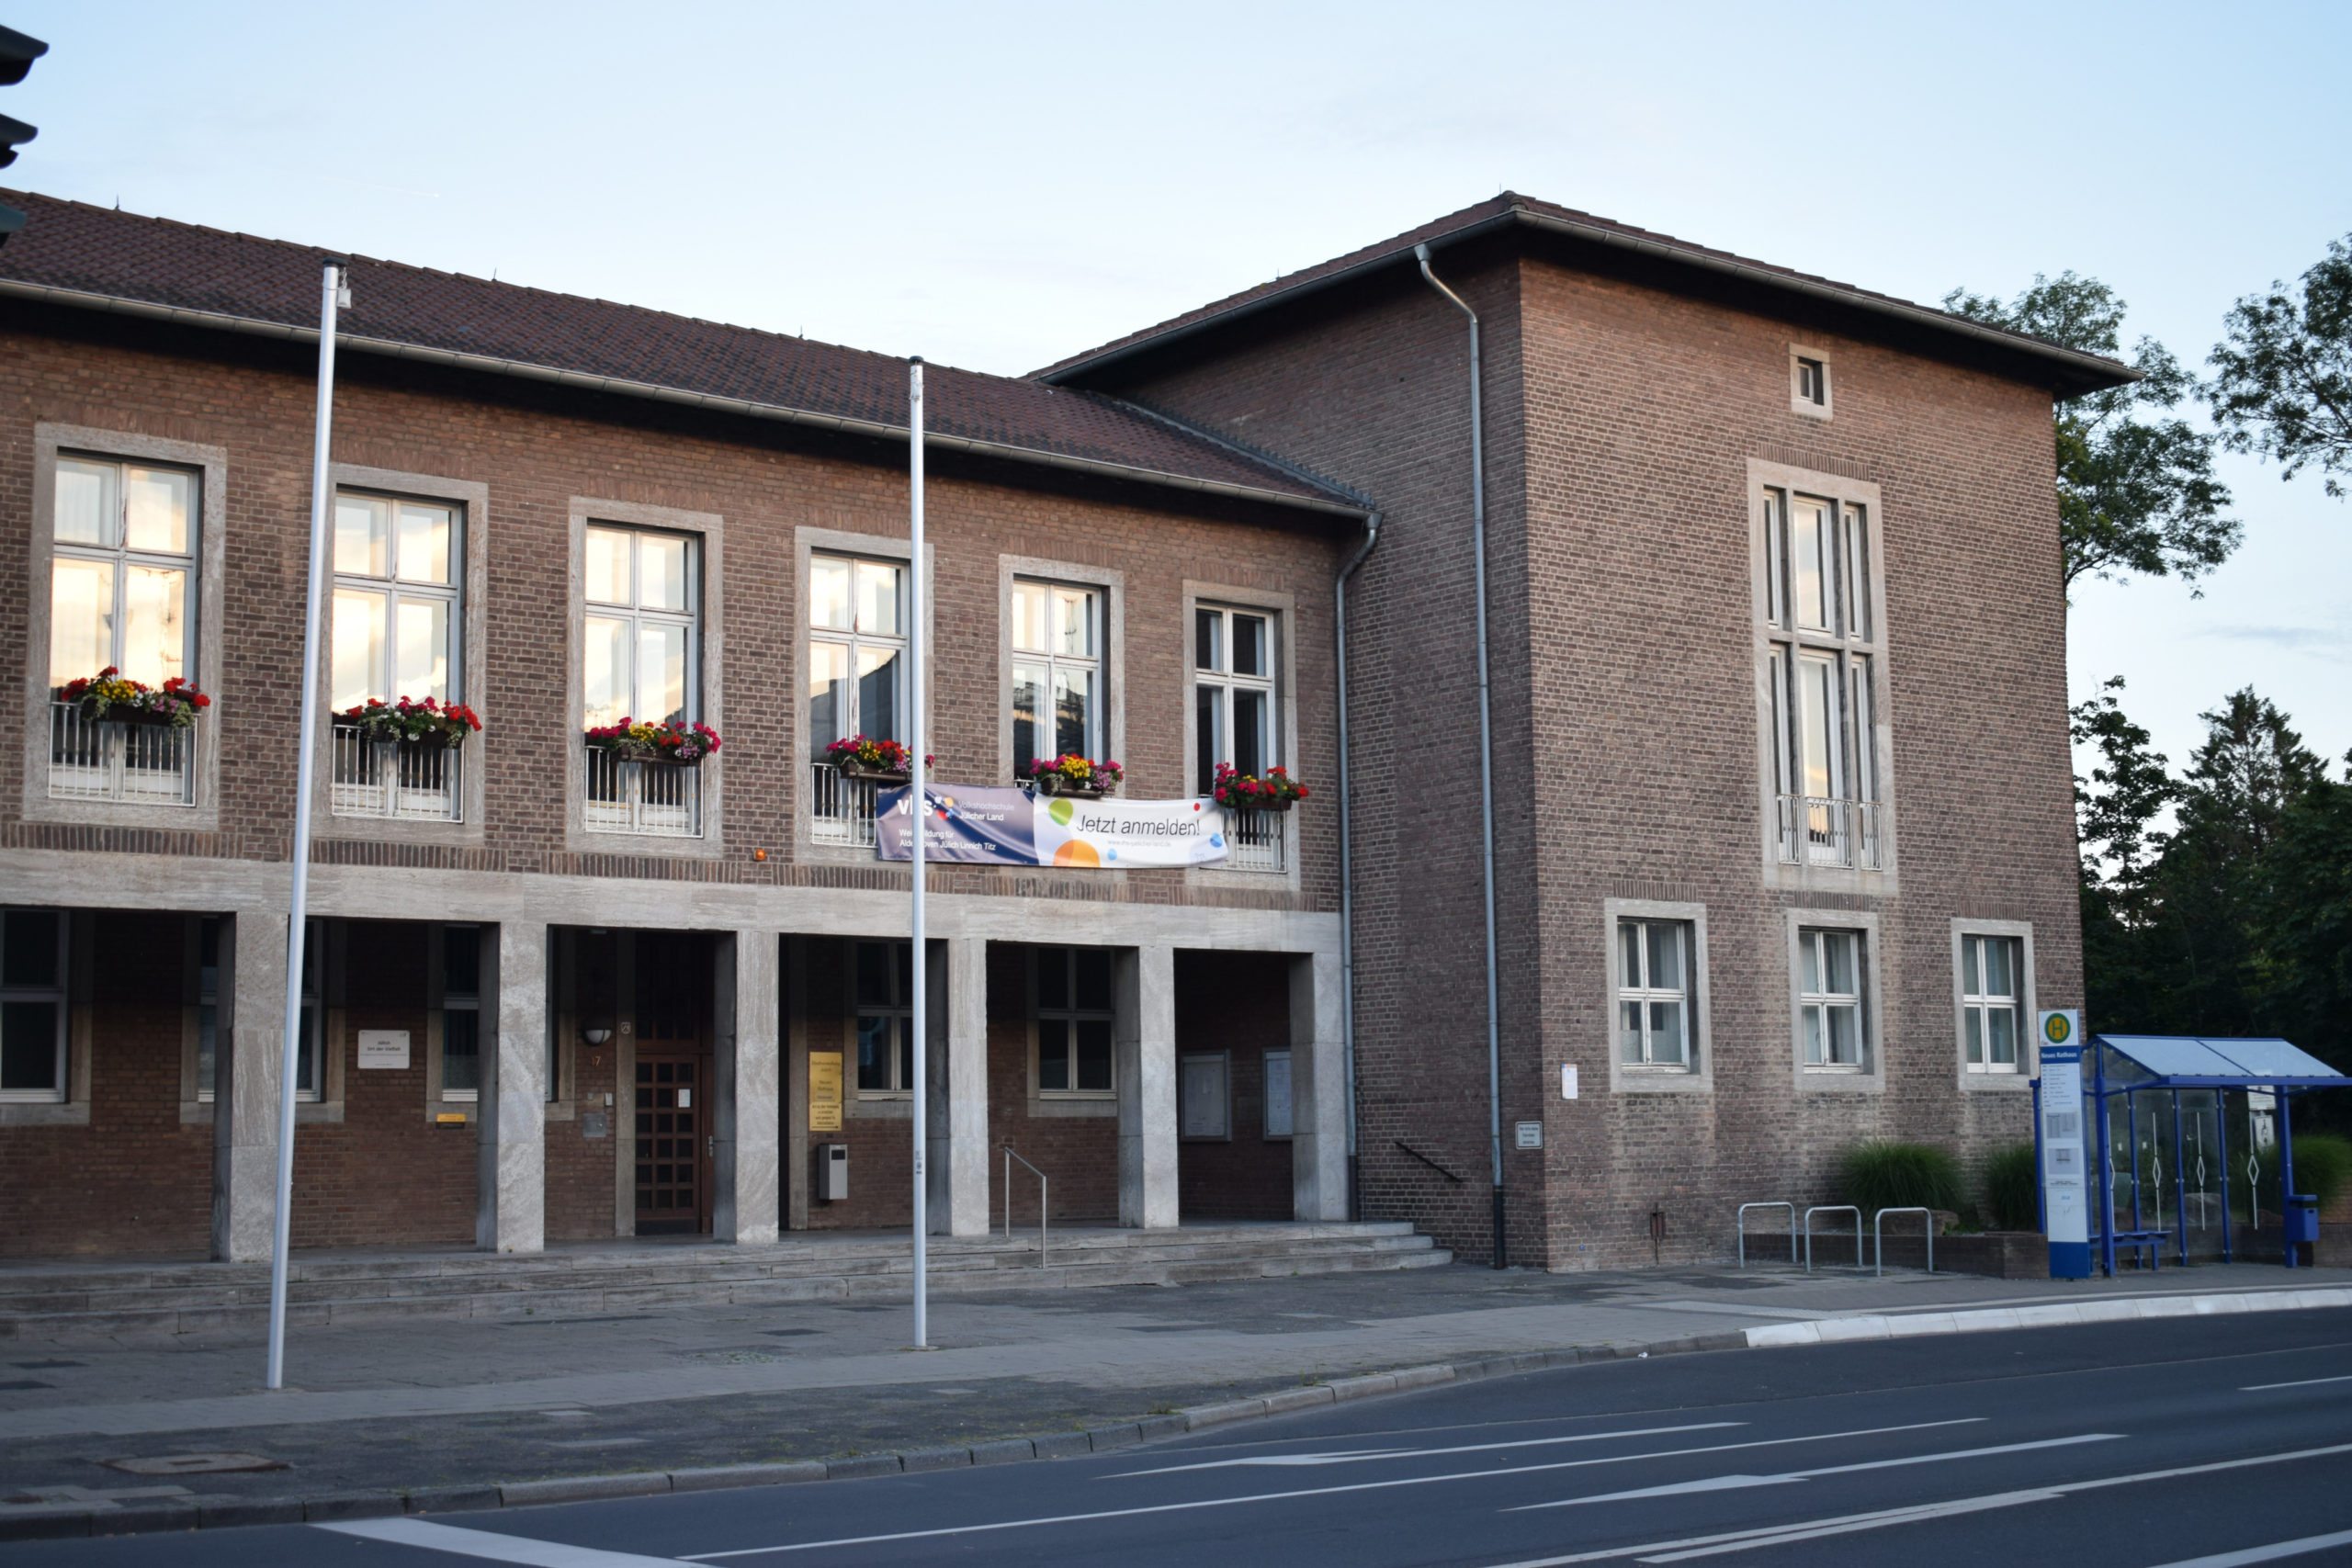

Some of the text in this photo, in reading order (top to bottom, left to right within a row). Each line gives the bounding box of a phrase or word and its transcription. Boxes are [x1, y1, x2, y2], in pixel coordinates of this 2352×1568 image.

[958, 800, 1015, 811] Volkshochschule
[960, 812, 1004, 821] Jülicher Land
[1077, 815, 1201, 836] Jetzt anmelden!
[945, 830, 955, 839] für
[940, 840, 958, 849] Jülich
[960, 841, 982, 850] Linnich
[984, 842, 996, 851] Titz
